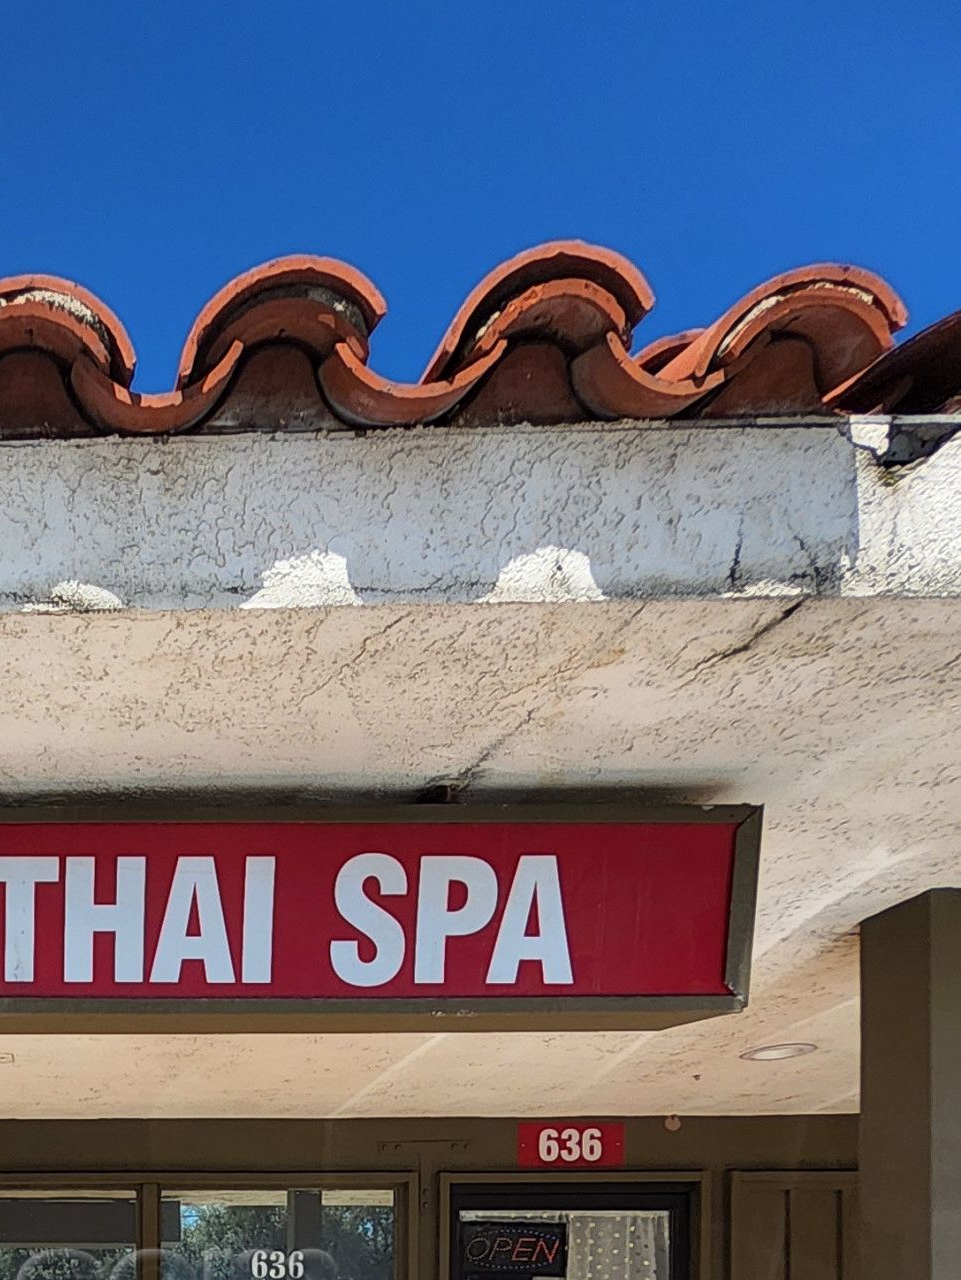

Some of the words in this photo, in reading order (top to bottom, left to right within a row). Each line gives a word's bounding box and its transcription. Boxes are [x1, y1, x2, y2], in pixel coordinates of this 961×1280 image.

[329, 852, 575, 988] SPA
[538, 1128, 603, 1162] 636
[251, 1250, 305, 1280] 636
[466, 1237, 559, 1263] OPEN
